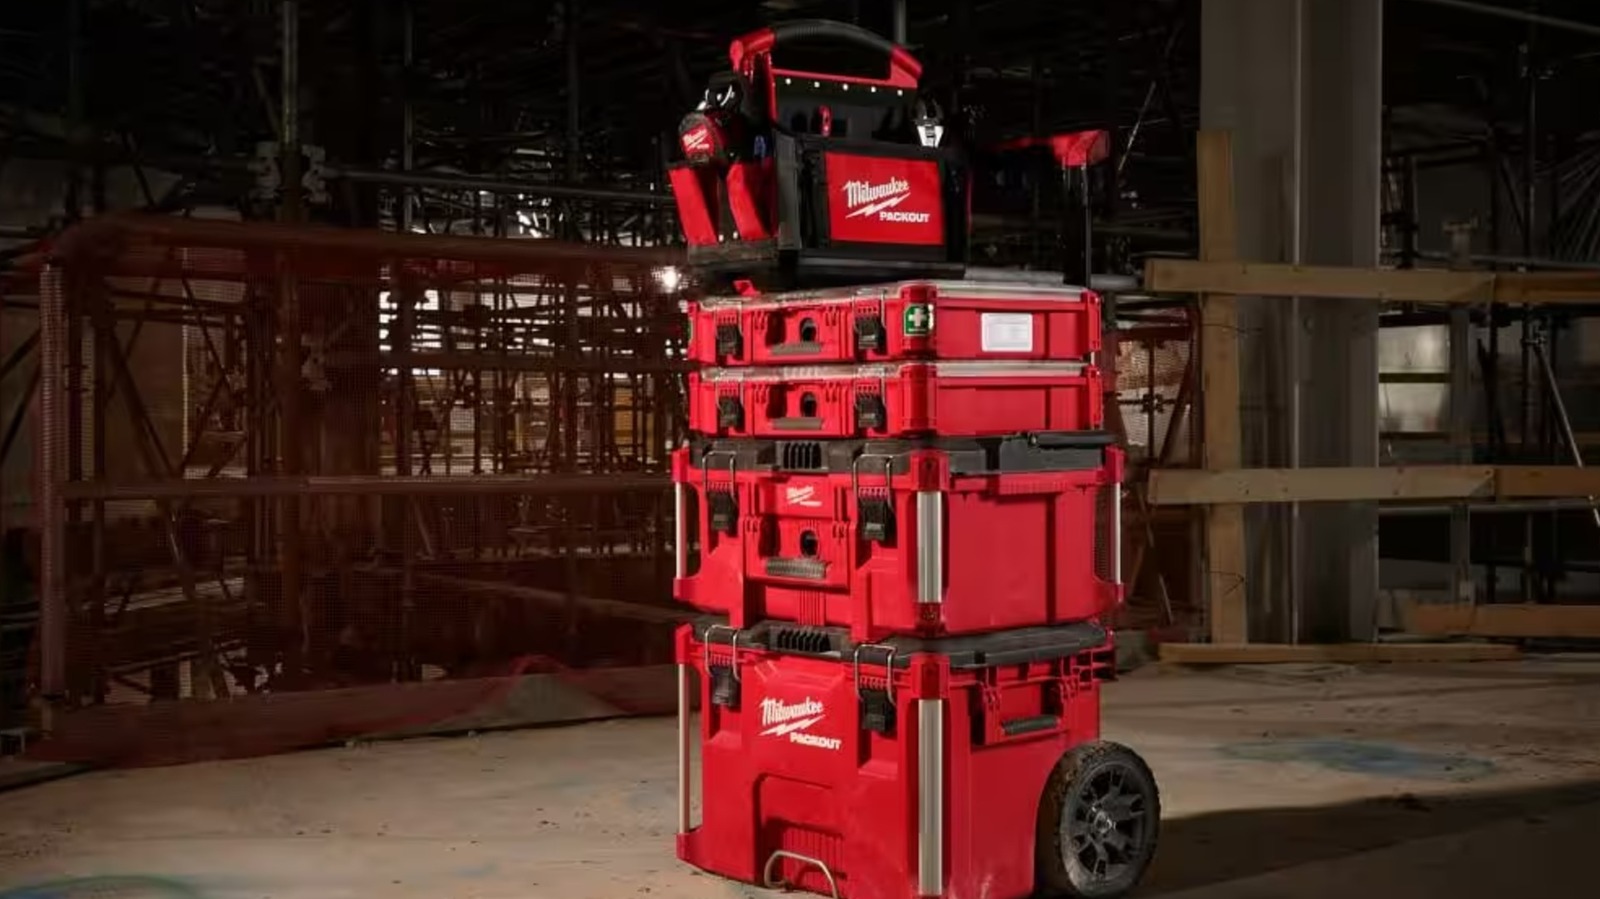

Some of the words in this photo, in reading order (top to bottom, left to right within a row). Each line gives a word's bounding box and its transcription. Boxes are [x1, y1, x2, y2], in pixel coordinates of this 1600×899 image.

[842, 176, 910, 208] Milwaukee
[880, 211, 930, 223] PACKOUT
[759, 696, 823, 726] Milwaukee
